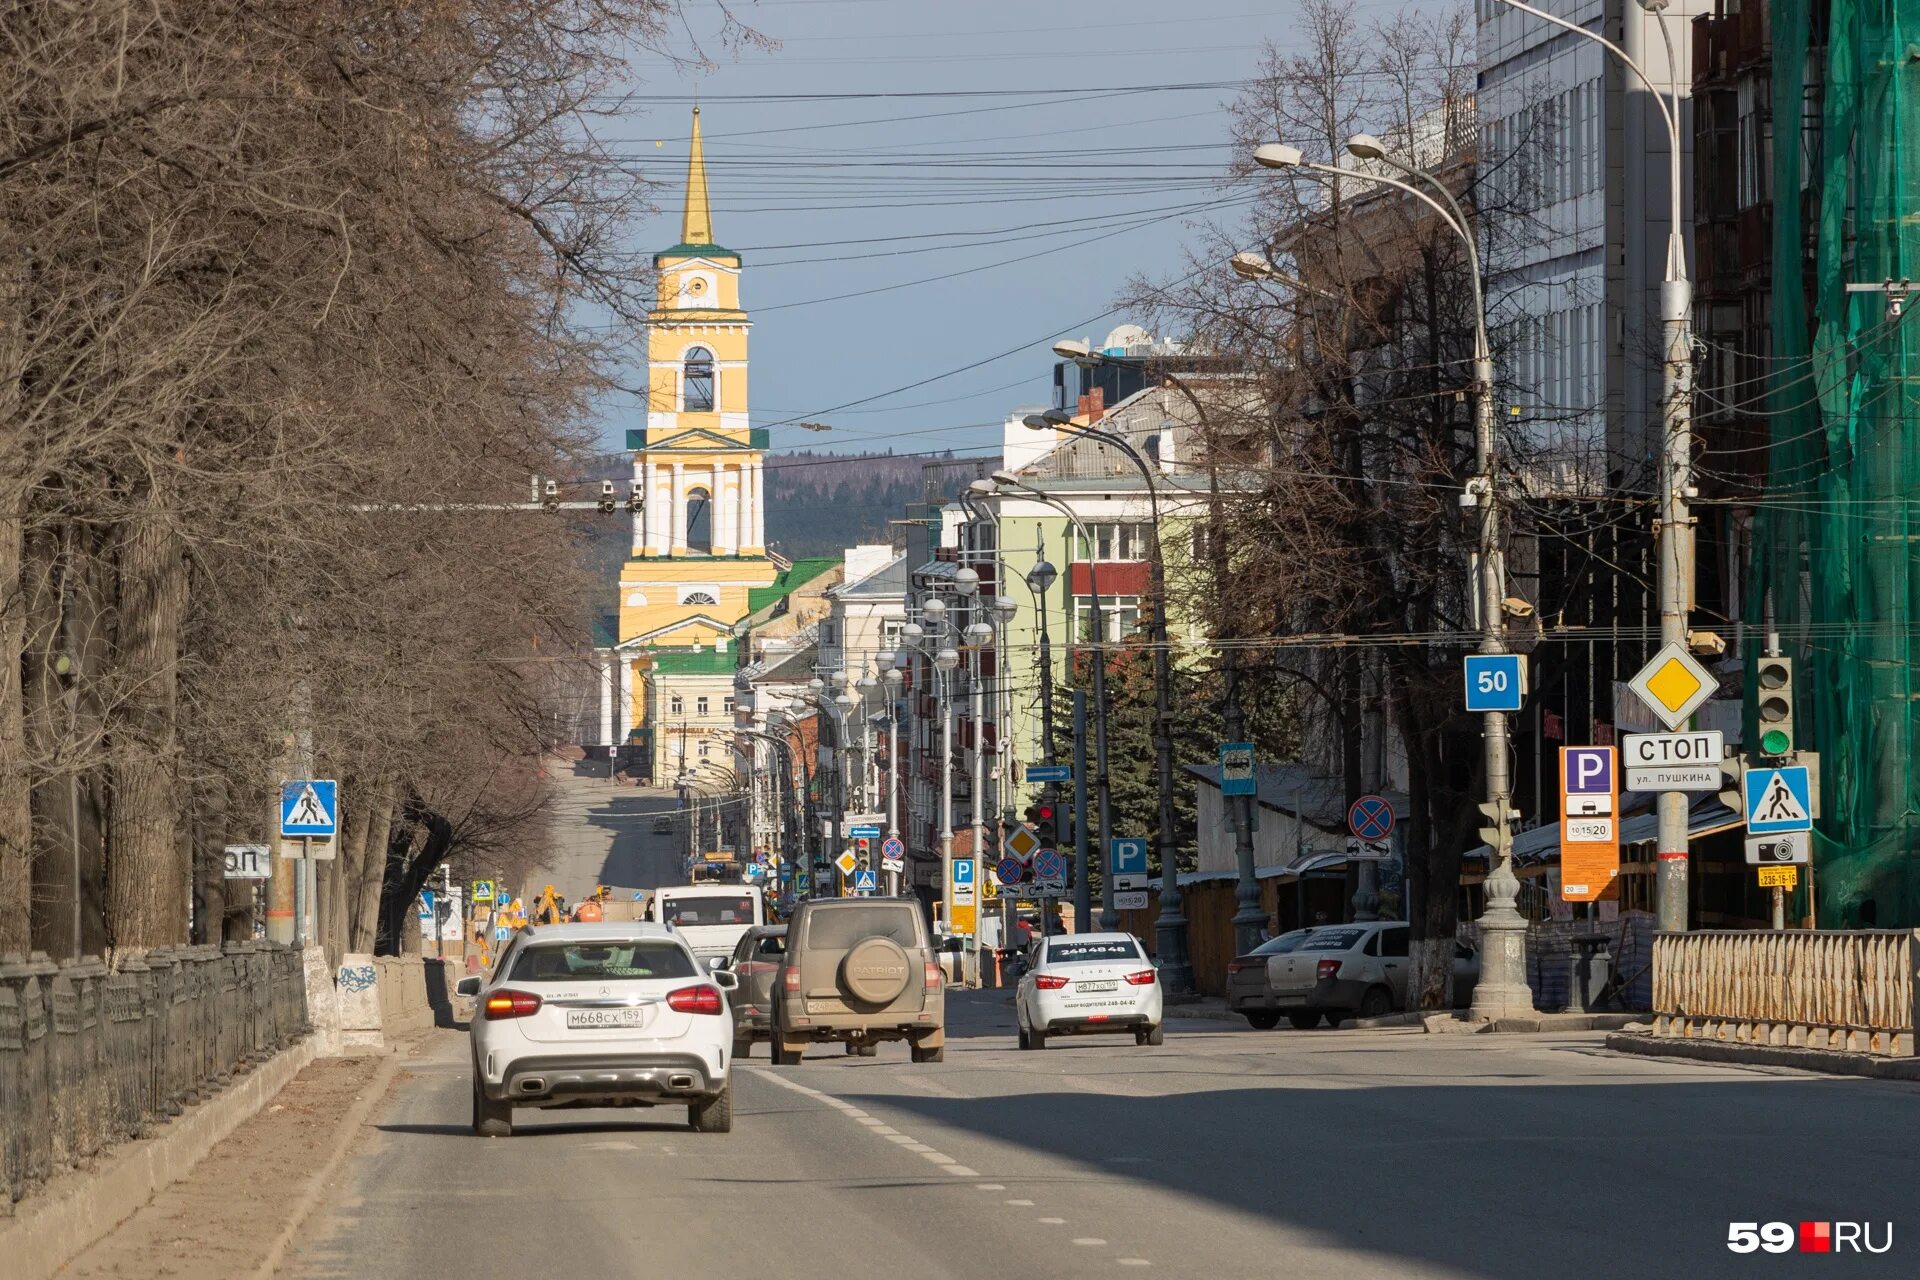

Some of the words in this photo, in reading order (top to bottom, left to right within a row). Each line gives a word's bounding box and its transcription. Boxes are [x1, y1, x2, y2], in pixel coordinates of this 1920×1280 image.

[1478, 670, 1508, 693] 50
[1639, 737, 1709, 761] СТОП
[1578, 753, 1604, 789] P
[1636, 776, 1651, 784] ул.
[1657, 773, 1712, 783] ПУШКИНА
[1582, 826, 1591, 834] 15
[1593, 825, 1606, 835] 20
[1118, 842, 1139, 869] P
[958, 862, 970, 881] P
[853, 966, 905, 975] PATRIOT
[622, 1010, 639, 1020] 159
